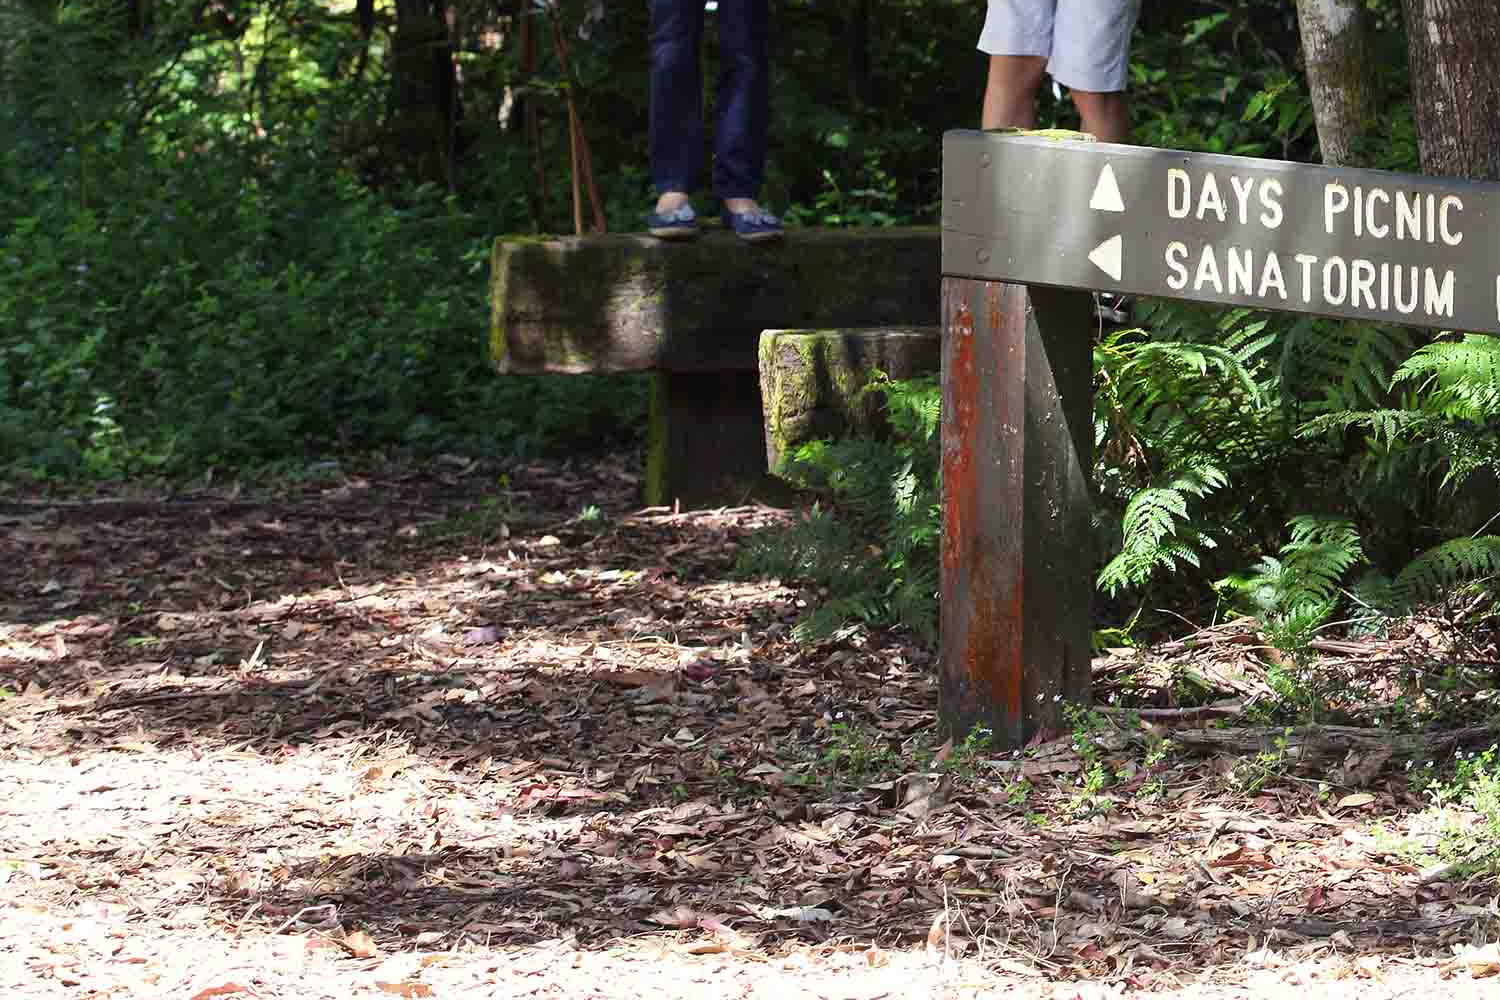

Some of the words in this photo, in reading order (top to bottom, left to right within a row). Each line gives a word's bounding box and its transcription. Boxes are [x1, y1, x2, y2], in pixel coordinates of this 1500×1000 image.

[1166, 167, 1285, 229] DAYS
[1323, 177, 1465, 246] PICNIC
[1164, 241, 1457, 318] SANATORIUM
